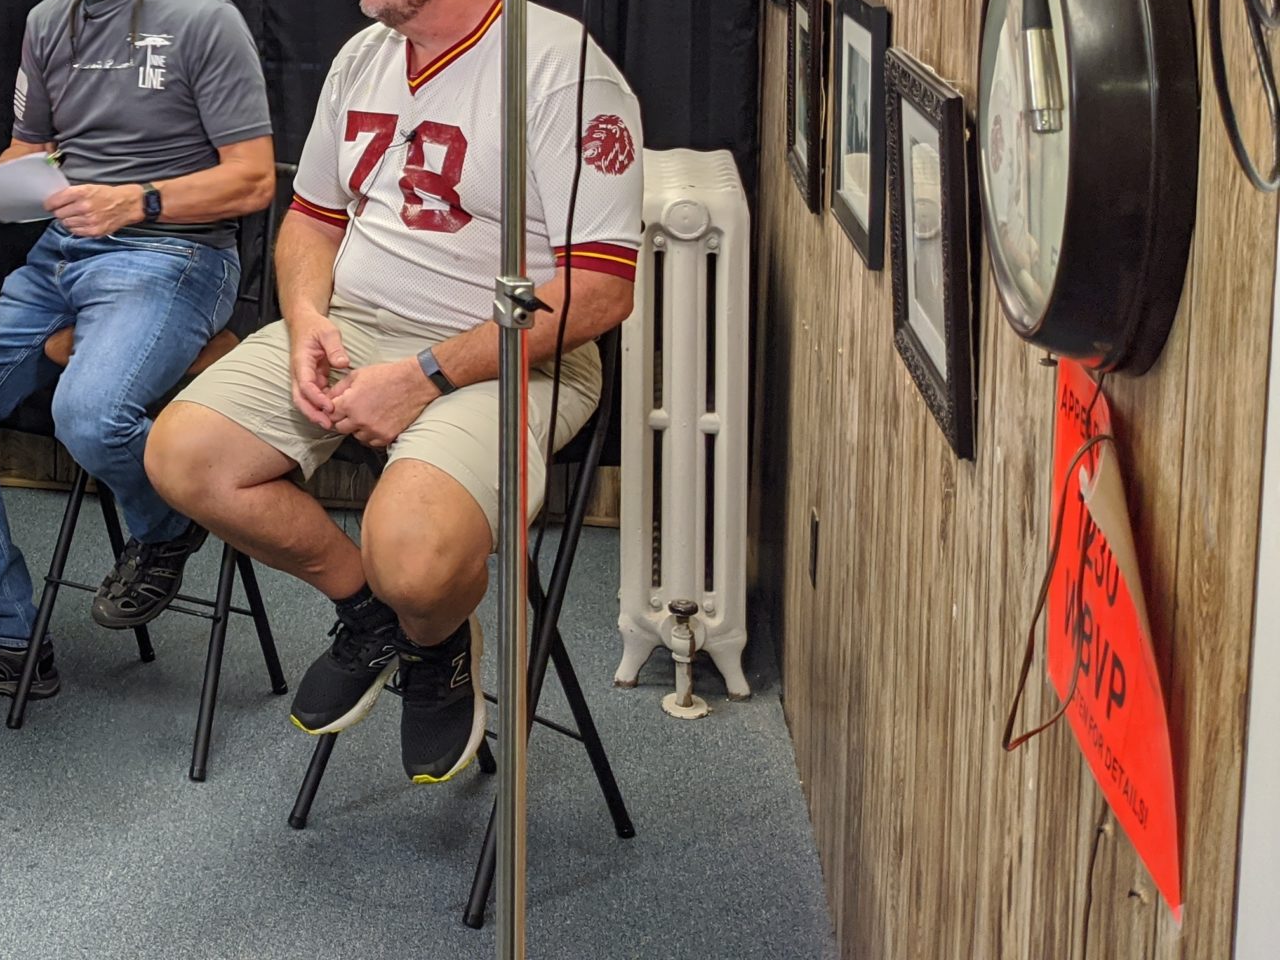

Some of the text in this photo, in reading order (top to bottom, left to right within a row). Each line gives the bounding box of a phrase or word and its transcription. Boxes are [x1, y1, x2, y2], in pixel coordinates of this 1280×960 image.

[344, 110, 473, 233] 78
[1064, 566, 1126, 721] WBVP
[1105, 744, 1150, 830] DETAILS!
